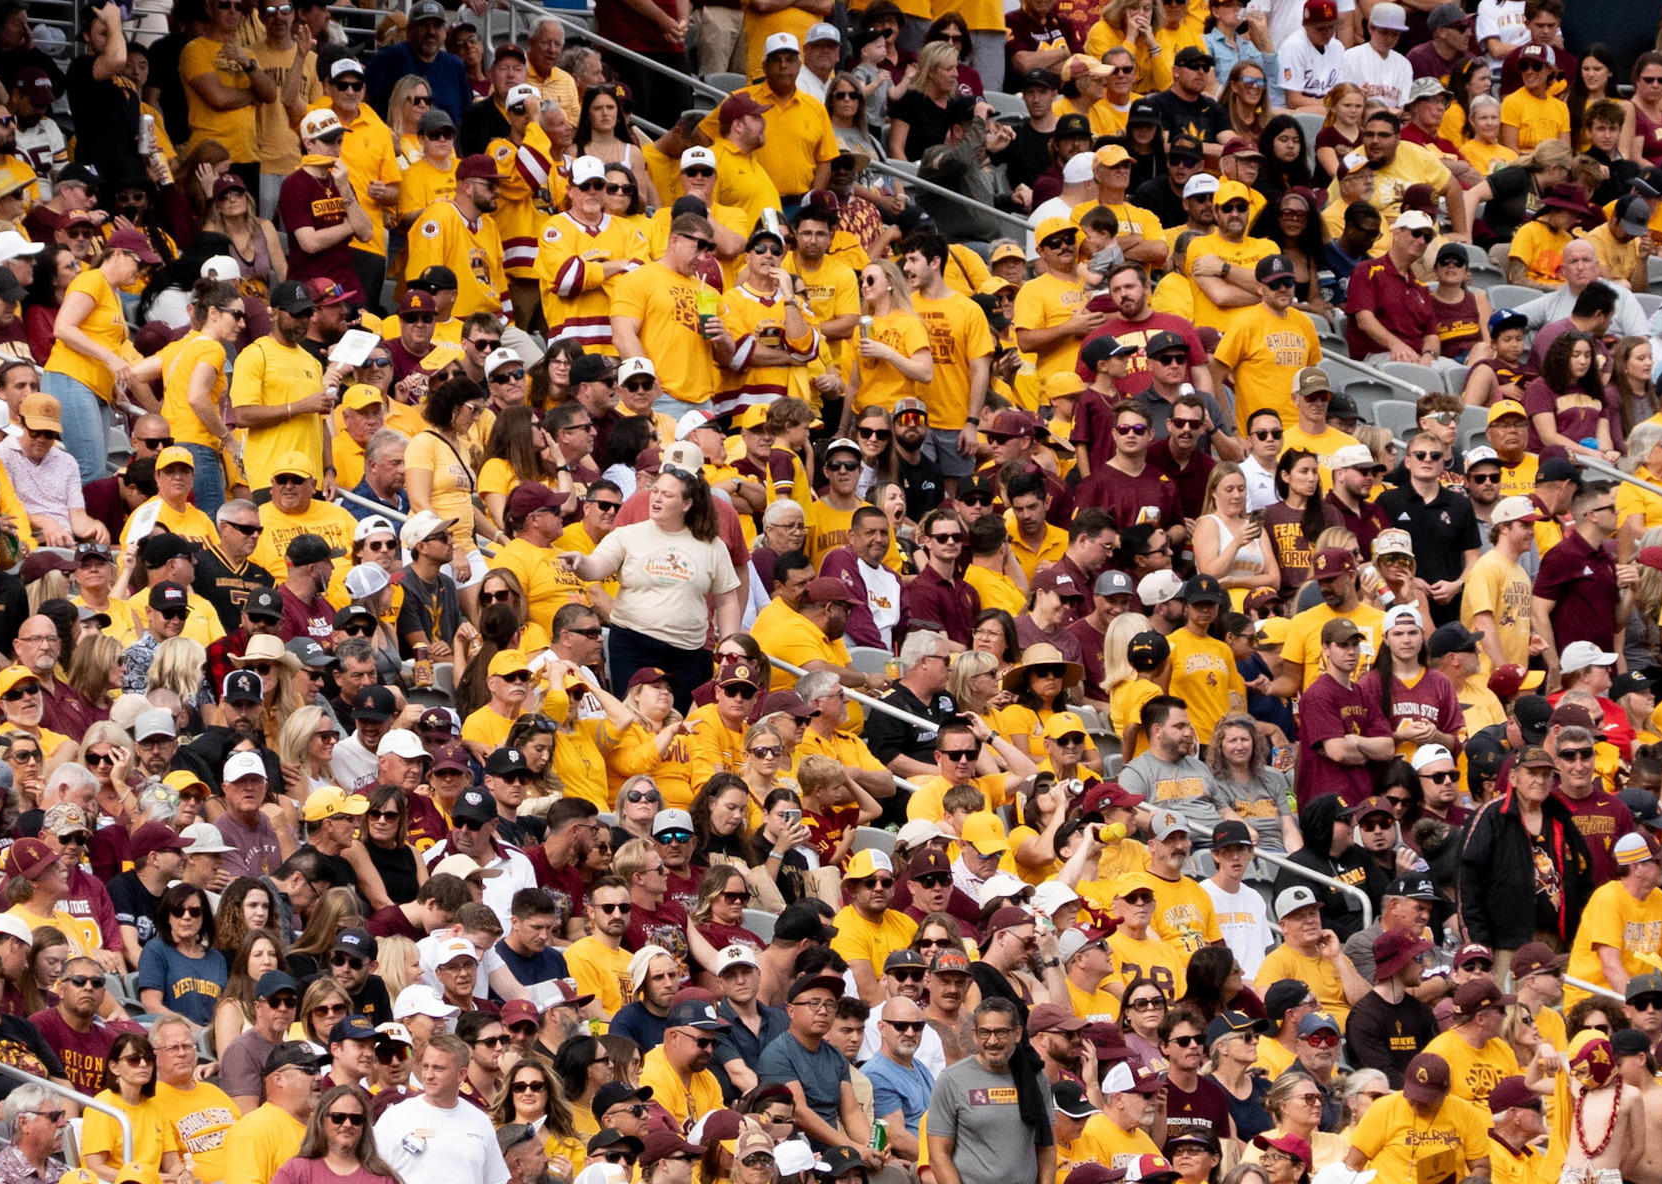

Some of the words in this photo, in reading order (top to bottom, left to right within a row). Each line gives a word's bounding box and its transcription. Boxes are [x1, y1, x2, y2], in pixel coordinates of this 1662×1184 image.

[1266, 330, 1307, 352] ARIZONA
[1275, 351, 1303, 367] STATE
[271, 525, 310, 541] ARIZONA
[1274, 522, 1304, 538] FEAR
[1279, 536, 1297, 551] THE
[1392, 702, 1420, 718] ARIZONA
[1420, 703, 1440, 721] STATE
[172, 977, 193, 1000] WEST
[65, 1067, 103, 1090] STATE
